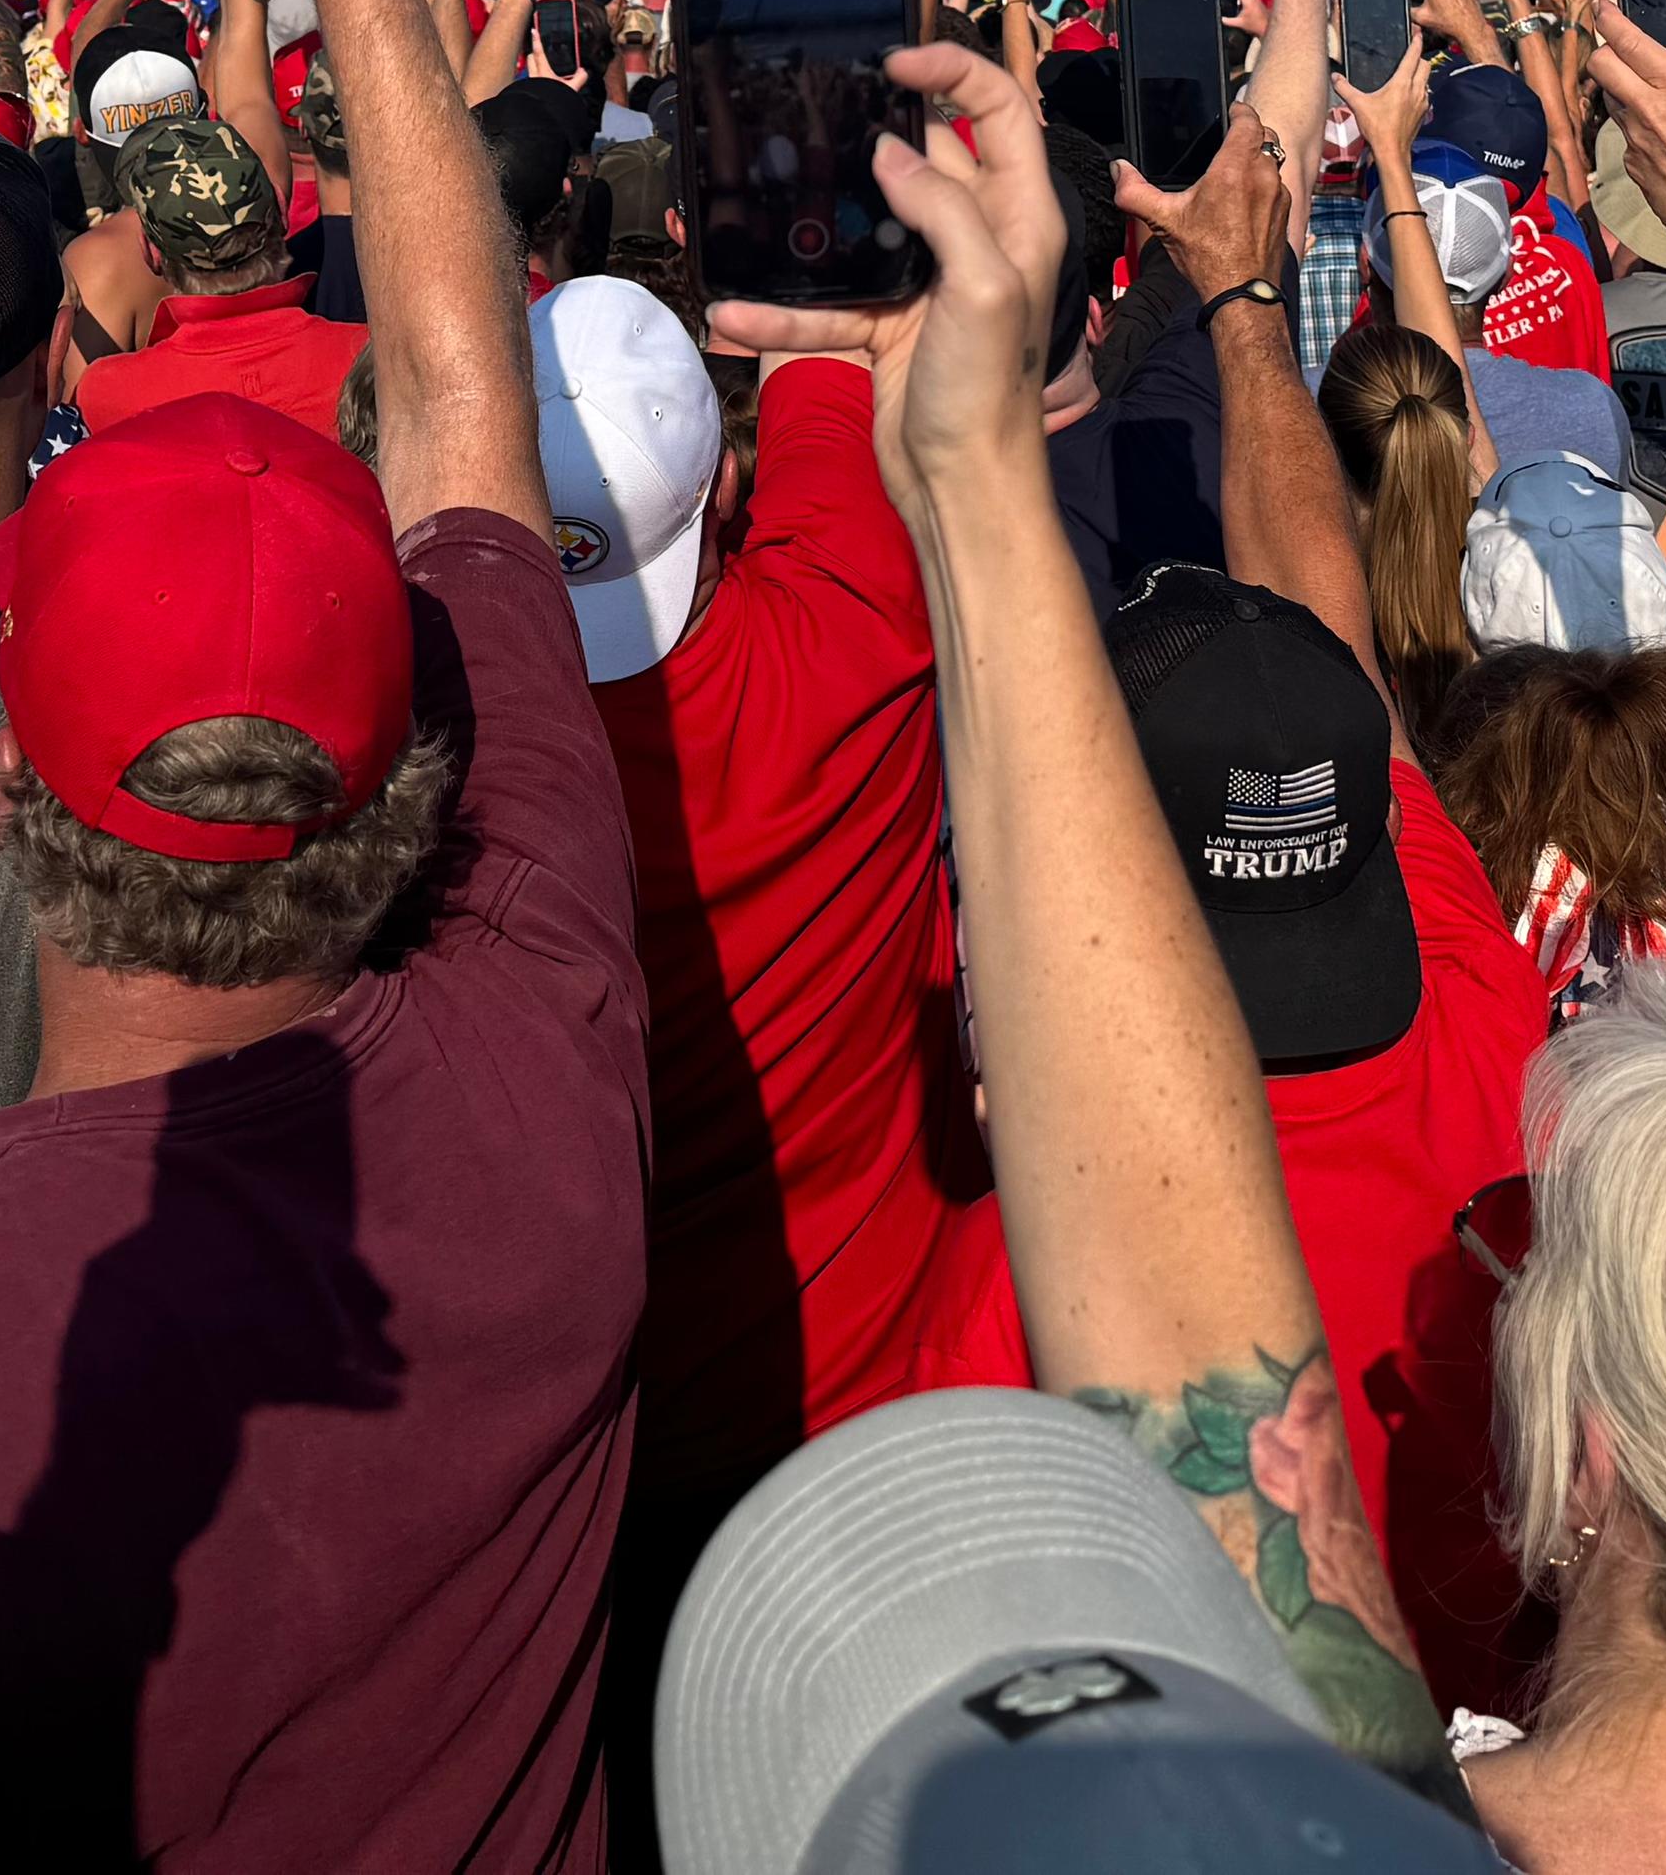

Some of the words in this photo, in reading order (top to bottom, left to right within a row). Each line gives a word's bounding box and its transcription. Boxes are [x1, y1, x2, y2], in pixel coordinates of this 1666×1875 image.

[100, 90, 194, 133] YINZER
[1483, 150, 1525, 169] TRUMP
[1483, 318, 1533, 347] TLER
[1206, 834, 1235, 848] LAW
[1240, 830, 1328, 850] ENFORCEMENT
[1329, 823, 1349, 839] FOR
[1204, 837, 1348, 879] TRUMP
